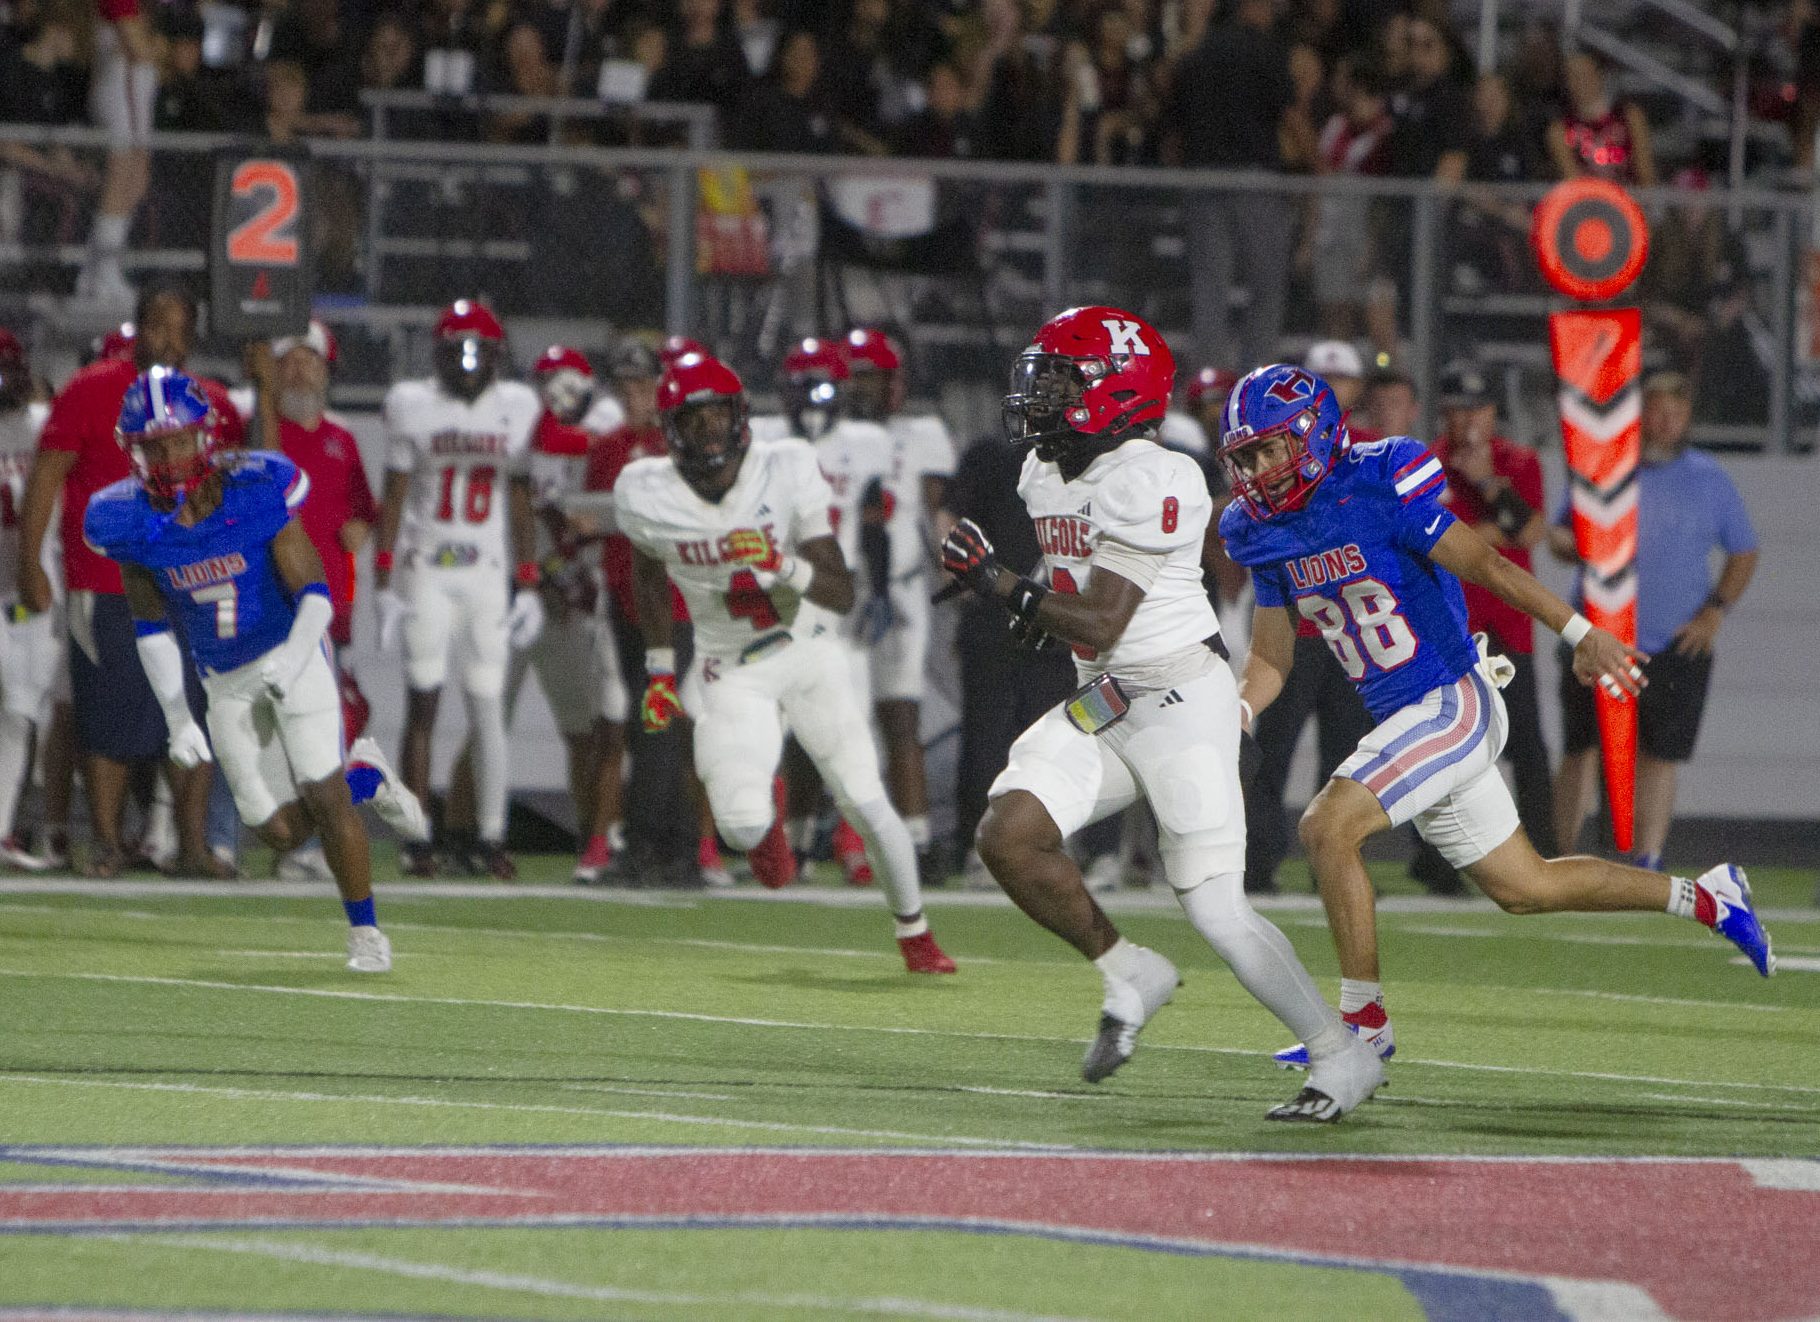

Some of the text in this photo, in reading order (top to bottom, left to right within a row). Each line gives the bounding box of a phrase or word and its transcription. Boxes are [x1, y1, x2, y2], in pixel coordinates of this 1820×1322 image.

[229, 161, 298, 263] 2
[1101, 319, 1150, 356] K
[1162, 496, 1178, 533] 8
[1286, 544, 1367, 589] LIONS
[191, 579, 238, 639] 7
[724, 567, 780, 630] 4
[1295, 575, 1420, 681] 88
